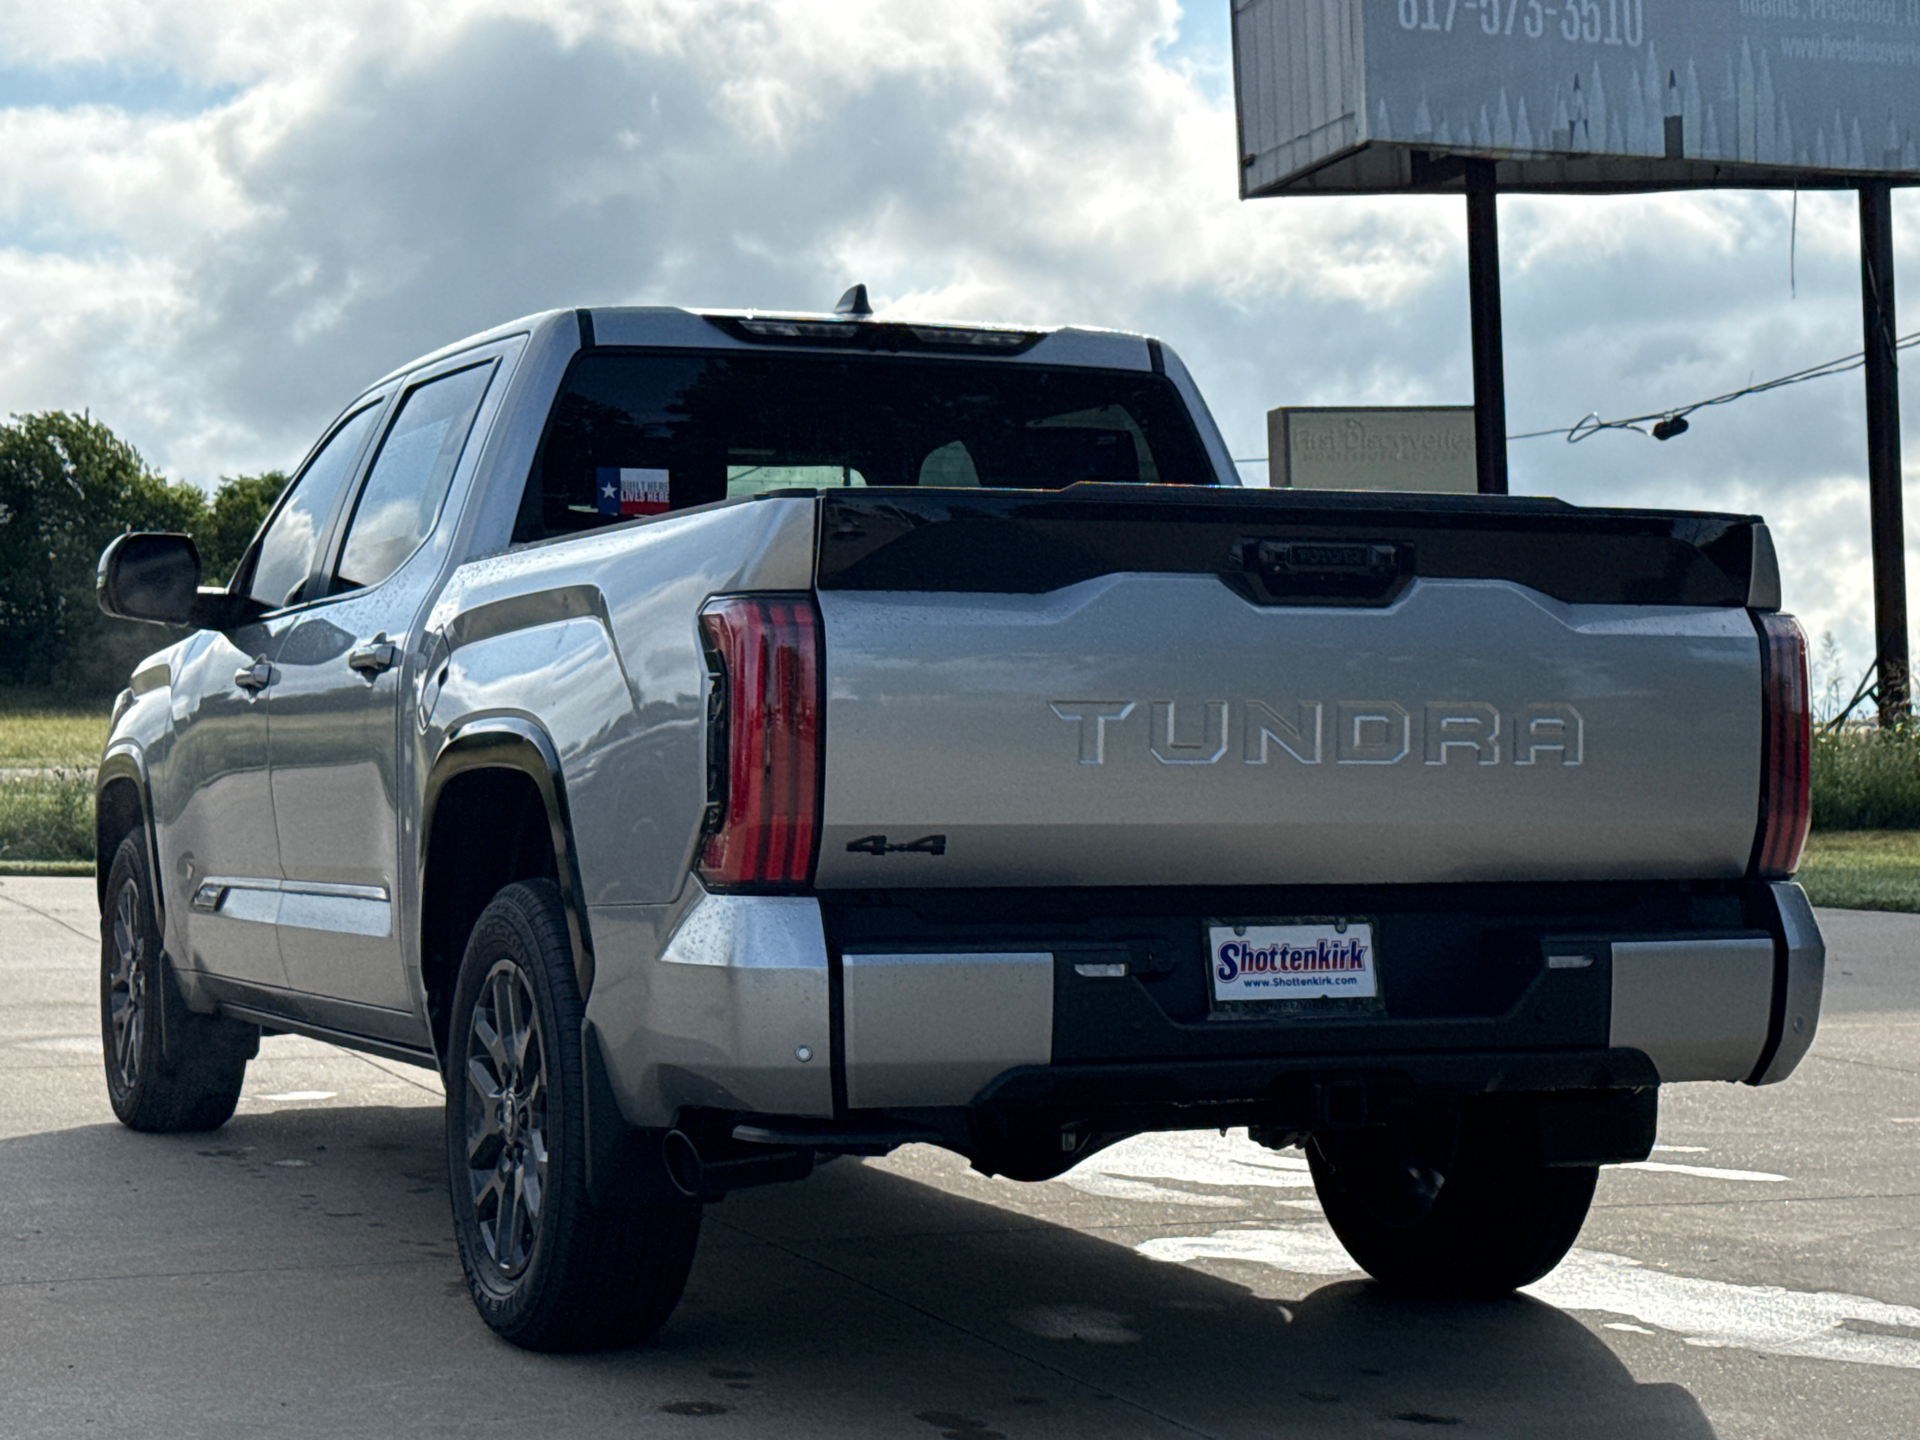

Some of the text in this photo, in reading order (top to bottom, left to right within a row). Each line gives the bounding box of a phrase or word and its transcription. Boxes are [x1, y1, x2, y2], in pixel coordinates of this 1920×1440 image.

[620, 490, 670, 503] LIVES HERE
[1048, 700, 1584, 767] TUNDRA
[1217, 939, 1367, 982] Shottenkirk
[1244, 975, 1358, 987] www.Shottenkirk.com
